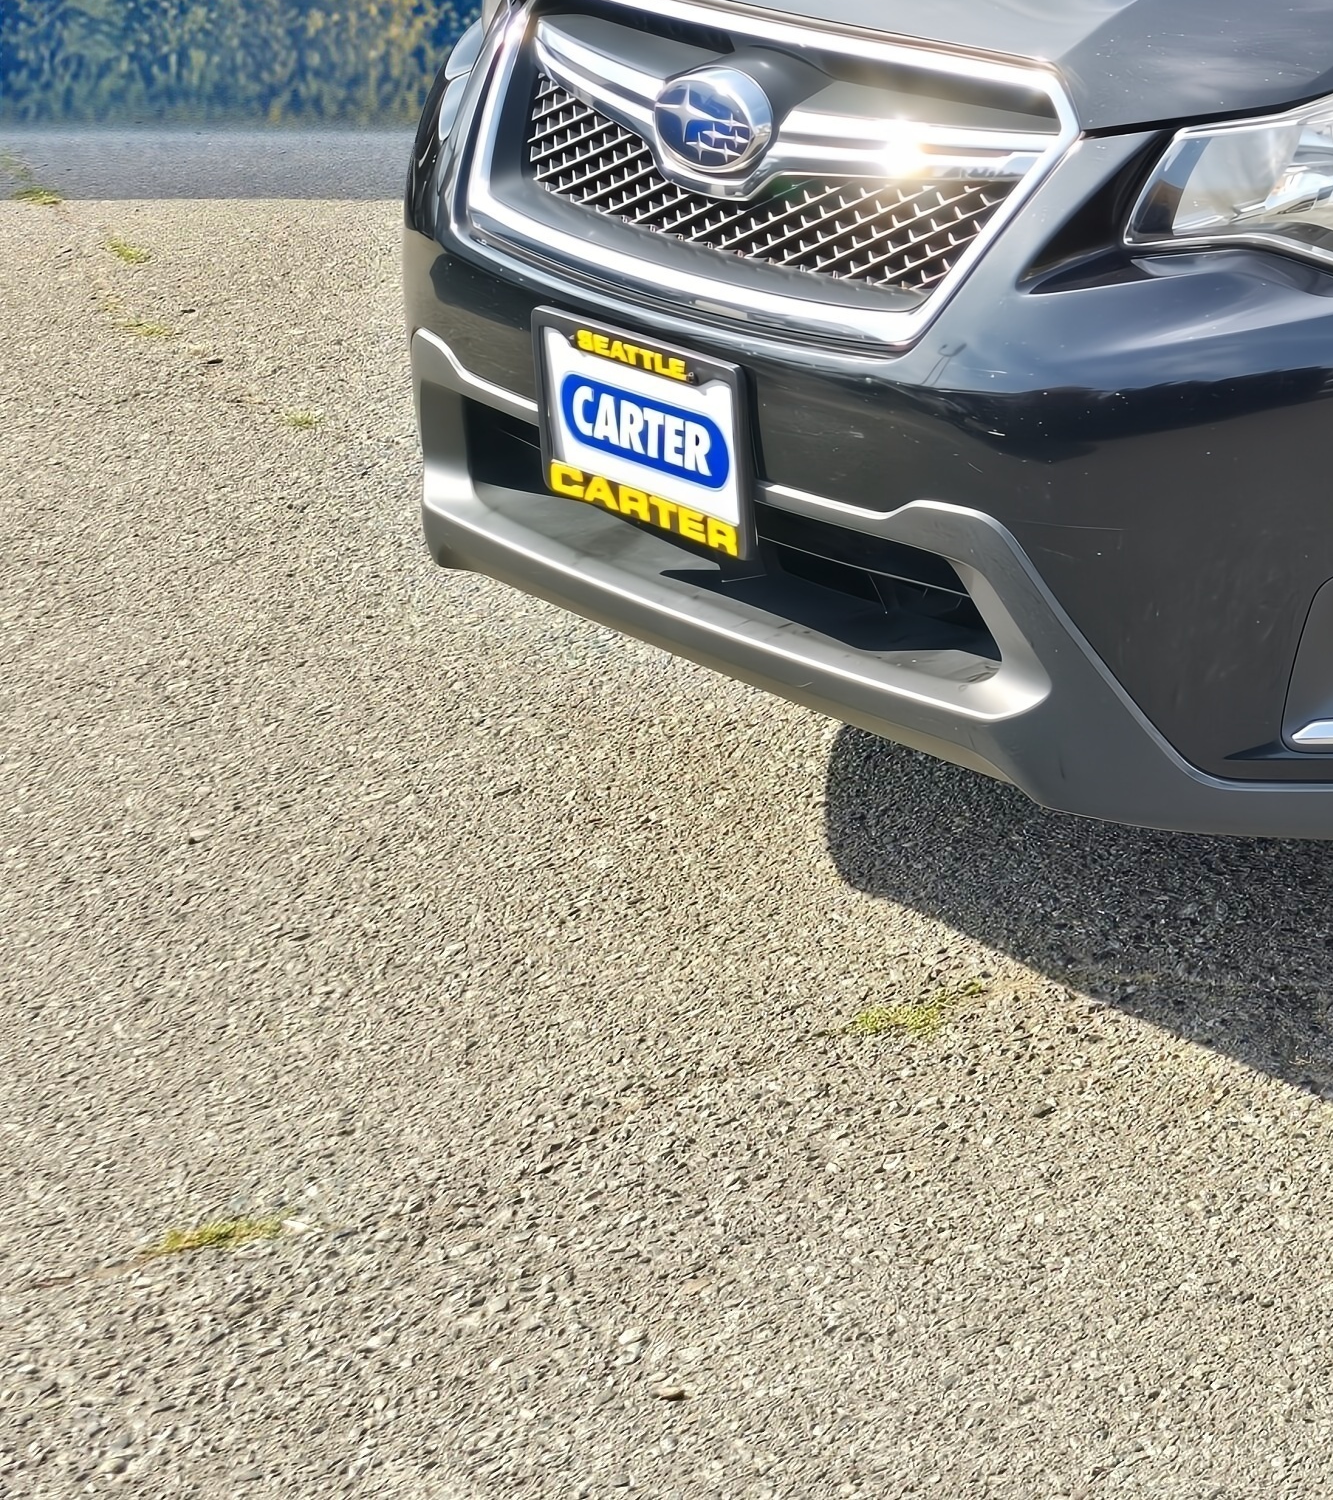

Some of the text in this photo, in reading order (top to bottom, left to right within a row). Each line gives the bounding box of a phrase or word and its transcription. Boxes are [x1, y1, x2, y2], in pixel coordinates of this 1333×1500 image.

[576, 329, 689, 381] SEATTLE
[572, 384, 713, 477] CARTER
[550, 461, 739, 558] CARTER
